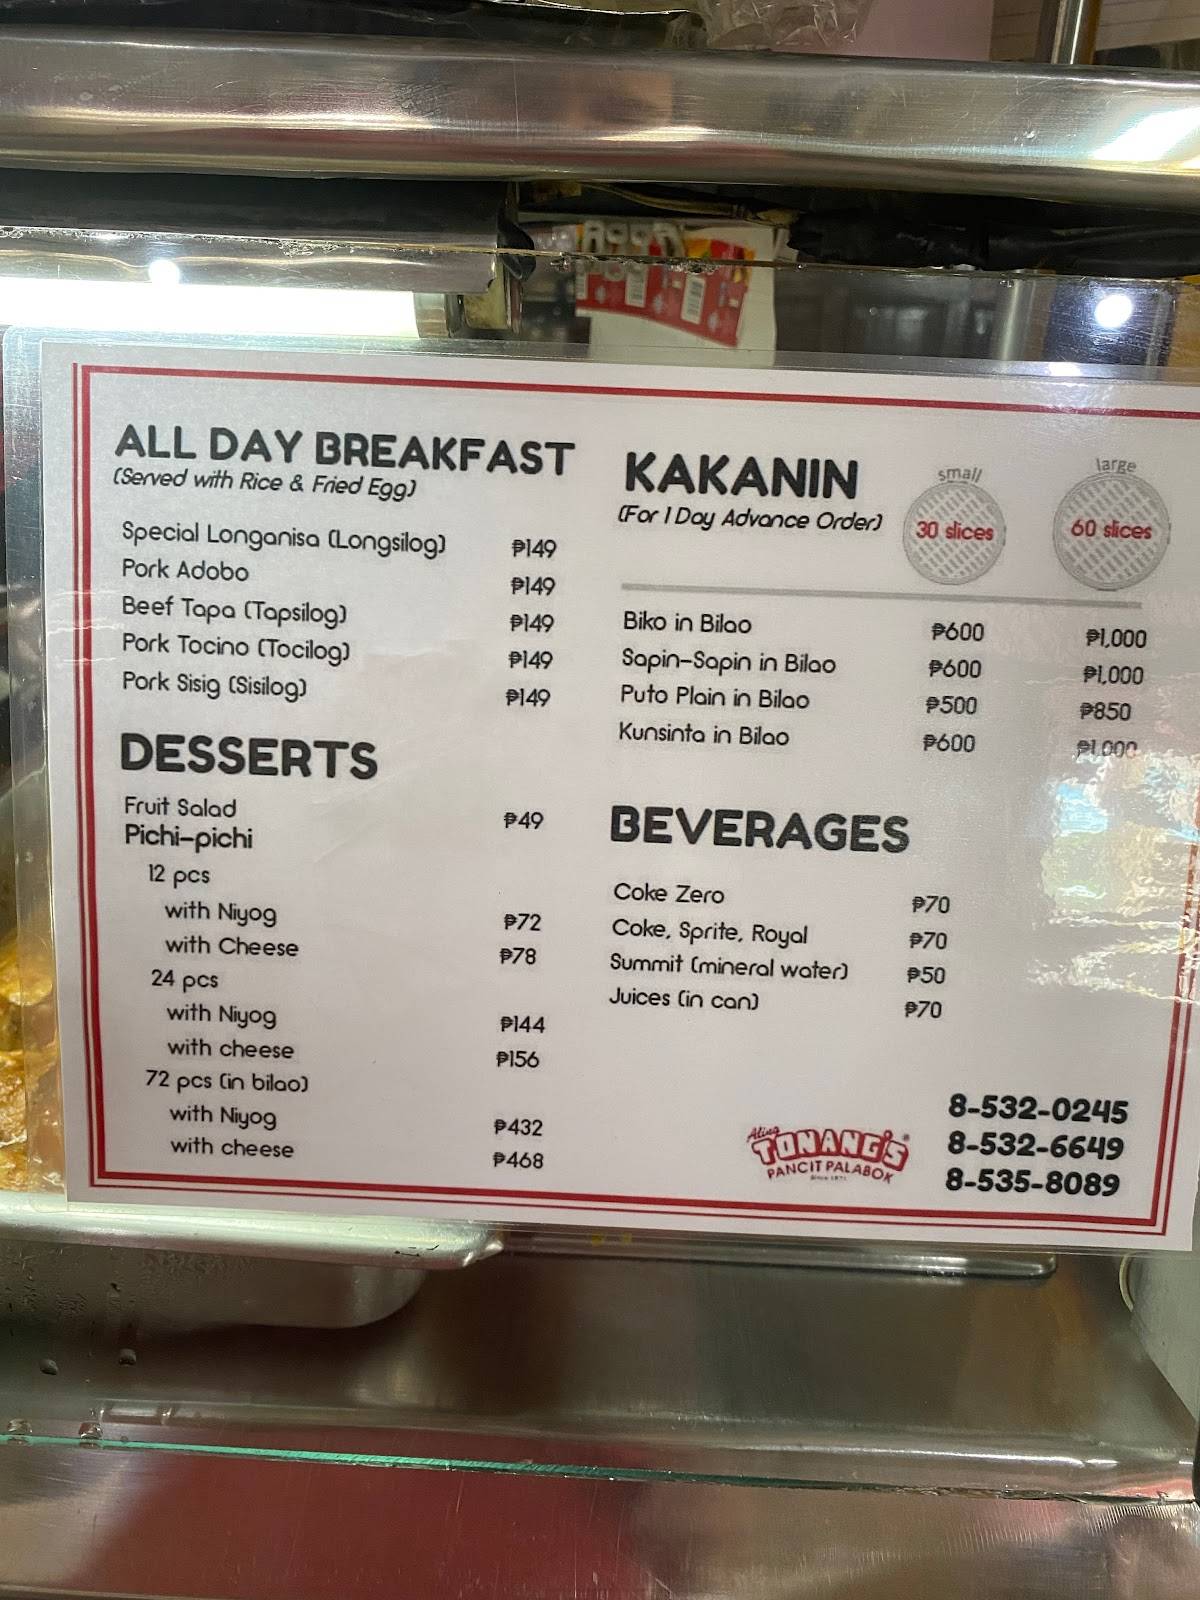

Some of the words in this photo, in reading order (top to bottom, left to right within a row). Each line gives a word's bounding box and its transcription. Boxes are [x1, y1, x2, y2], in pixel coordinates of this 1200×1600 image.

[115, 424, 197, 459] ALL
[210, 427, 303, 464] DAY
[316, 431, 576, 476] BREAKFAST
[625, 451, 858, 499] KAKANIN
[938, 468, 982, 484] small
[1097, 459, 1136, 474] large
[113, 467, 189, 487] (Served
[194, 469, 234, 489] with
[240, 472, 283, 491] Rice
[289, 474, 304, 492] &
[312, 475, 364, 494] Fried
[367, 478, 417, 502] Egg)
[617, 504, 660, 523] (For
[664, 505, 672, 524] 1
[674, 506, 716, 531] Day
[720, 507, 810, 529] Advance
[816, 511, 883, 531] Order)
[916, 521, 938, 539] 30
[946, 521, 994, 541] slices
[1071, 519, 1096, 537] 60
[1104, 520, 1150, 539] slices
[123, 521, 199, 547] Special
[208, 524, 320, 551] Longanisa
[328, 529, 445, 560] (Longsilog)
[512, 539, 557, 559] ₱149
[122, 558, 170, 578] Pork
[176, 560, 249, 582] Adobo
[511, 576, 556, 596] ₱149
[122, 595, 174, 616] Beef
[180, 597, 236, 625] Tapa
[245, 601, 347, 630] (Tapsilog)
[510, 613, 555, 633] ₱149
[624, 610, 667, 631] Biko
[675, 613, 693, 632] in
[700, 613, 752, 634] Bilao
[931, 622, 984, 642] ₱600
[1086, 628, 1147, 648] ₱1,000
[123, 633, 169, 653] Pork
[177, 635, 250, 656] Tocino
[258, 638, 350, 667] (Tocilog)
[508, 650, 553, 669] ₱149
[622, 648, 751, 676] Sapin-Sapin
[760, 652, 777, 672] in
[784, 653, 836, 673] Bilao
[928, 659, 982, 678] ₱600
[1083, 665, 1144, 685] ₱1,000
[123, 671, 170, 691] Pork
[177, 673, 221, 700] Sisig
[229, 675, 307, 703] (Sisilog)
[505, 688, 551, 707] ₱149
[621, 684, 668, 704] Puto
[676, 685, 726, 706] Plain
[733, 688, 751, 707] in
[759, 689, 810, 709] Bilao
[925, 696, 977, 715] ₱500
[1080, 702, 1131, 721] ₱850
[619, 721, 705, 743] Kunsinta
[713, 725, 731, 744] in
[739, 726, 790, 746] Bilao
[923, 733, 976, 753] ₱600
[121, 732, 378, 780] DESSERTS
[1075, 739, 1138, 759] ₱1000
[125, 796, 170, 815] Fruit
[178, 798, 236, 818] Salad
[504, 811, 544, 829] ₱49
[610, 805, 910, 853] BEVERAGES
[125, 823, 253, 854] Pichi-pichi
[149, 864, 165, 882] 12
[173, 870, 210, 889] pcs
[614, 882, 668, 902] Coke
[675, 885, 725, 904] Zero
[165, 901, 210, 919] with
[218, 903, 277, 928] Niyog
[912, 896, 950, 914] ₱70
[504, 913, 541, 931] ₱72
[612, 918, 671, 939] Coke,
[679, 921, 743, 945] Sprite,
[752, 924, 808, 949] Royal
[909, 931, 947, 950] ₱70
[165, 935, 210, 954] with
[218, 936, 299, 957] Cheese
[499, 947, 536, 966] ₱78
[610, 953, 684, 972] Summit
[691, 956, 774, 977] (mineral
[781, 960, 848, 980] water)
[907, 966, 946, 984] ₱50
[152, 969, 175, 986] 24
[183, 975, 218, 993] pcs
[609, 987, 670, 1006] Juices
[678, 990, 703, 1008] (in
[711, 993, 759, 1010] can)
[904, 1001, 942, 1018] ₱70
[167, 1003, 211, 1021] with
[219, 1005, 277, 1030] Niyog
[500, 1015, 546, 1033] ₱144
[168, 1038, 211, 1056] with
[220, 1039, 294, 1059] cheese
[496, 1050, 540, 1068] ₱156
[146, 1070, 170, 1087] 72
[177, 1076, 212, 1094] pcs
[220, 1073, 244, 1090] (in
[252, 1073, 308, 1092] bilao)
[170, 1105, 213, 1122] with
[221, 1106, 277, 1131] Niyog
[948, 1093, 1129, 1124] 8-532-0245
[494, 1118, 543, 1136] ₱432
[171, 1137, 213, 1154] with
[221, 1139, 294, 1158] cheese
[751, 1129, 909, 1172] TONANG'S
[948, 1130, 1125, 1160] 8-532-6649
[493, 1151, 544, 1169] ₱468
[767, 1160, 822, 1179] PANCIT
[826, 1161, 894, 1184] PALABOK
[945, 1167, 1120, 1196] 8-535-8089
